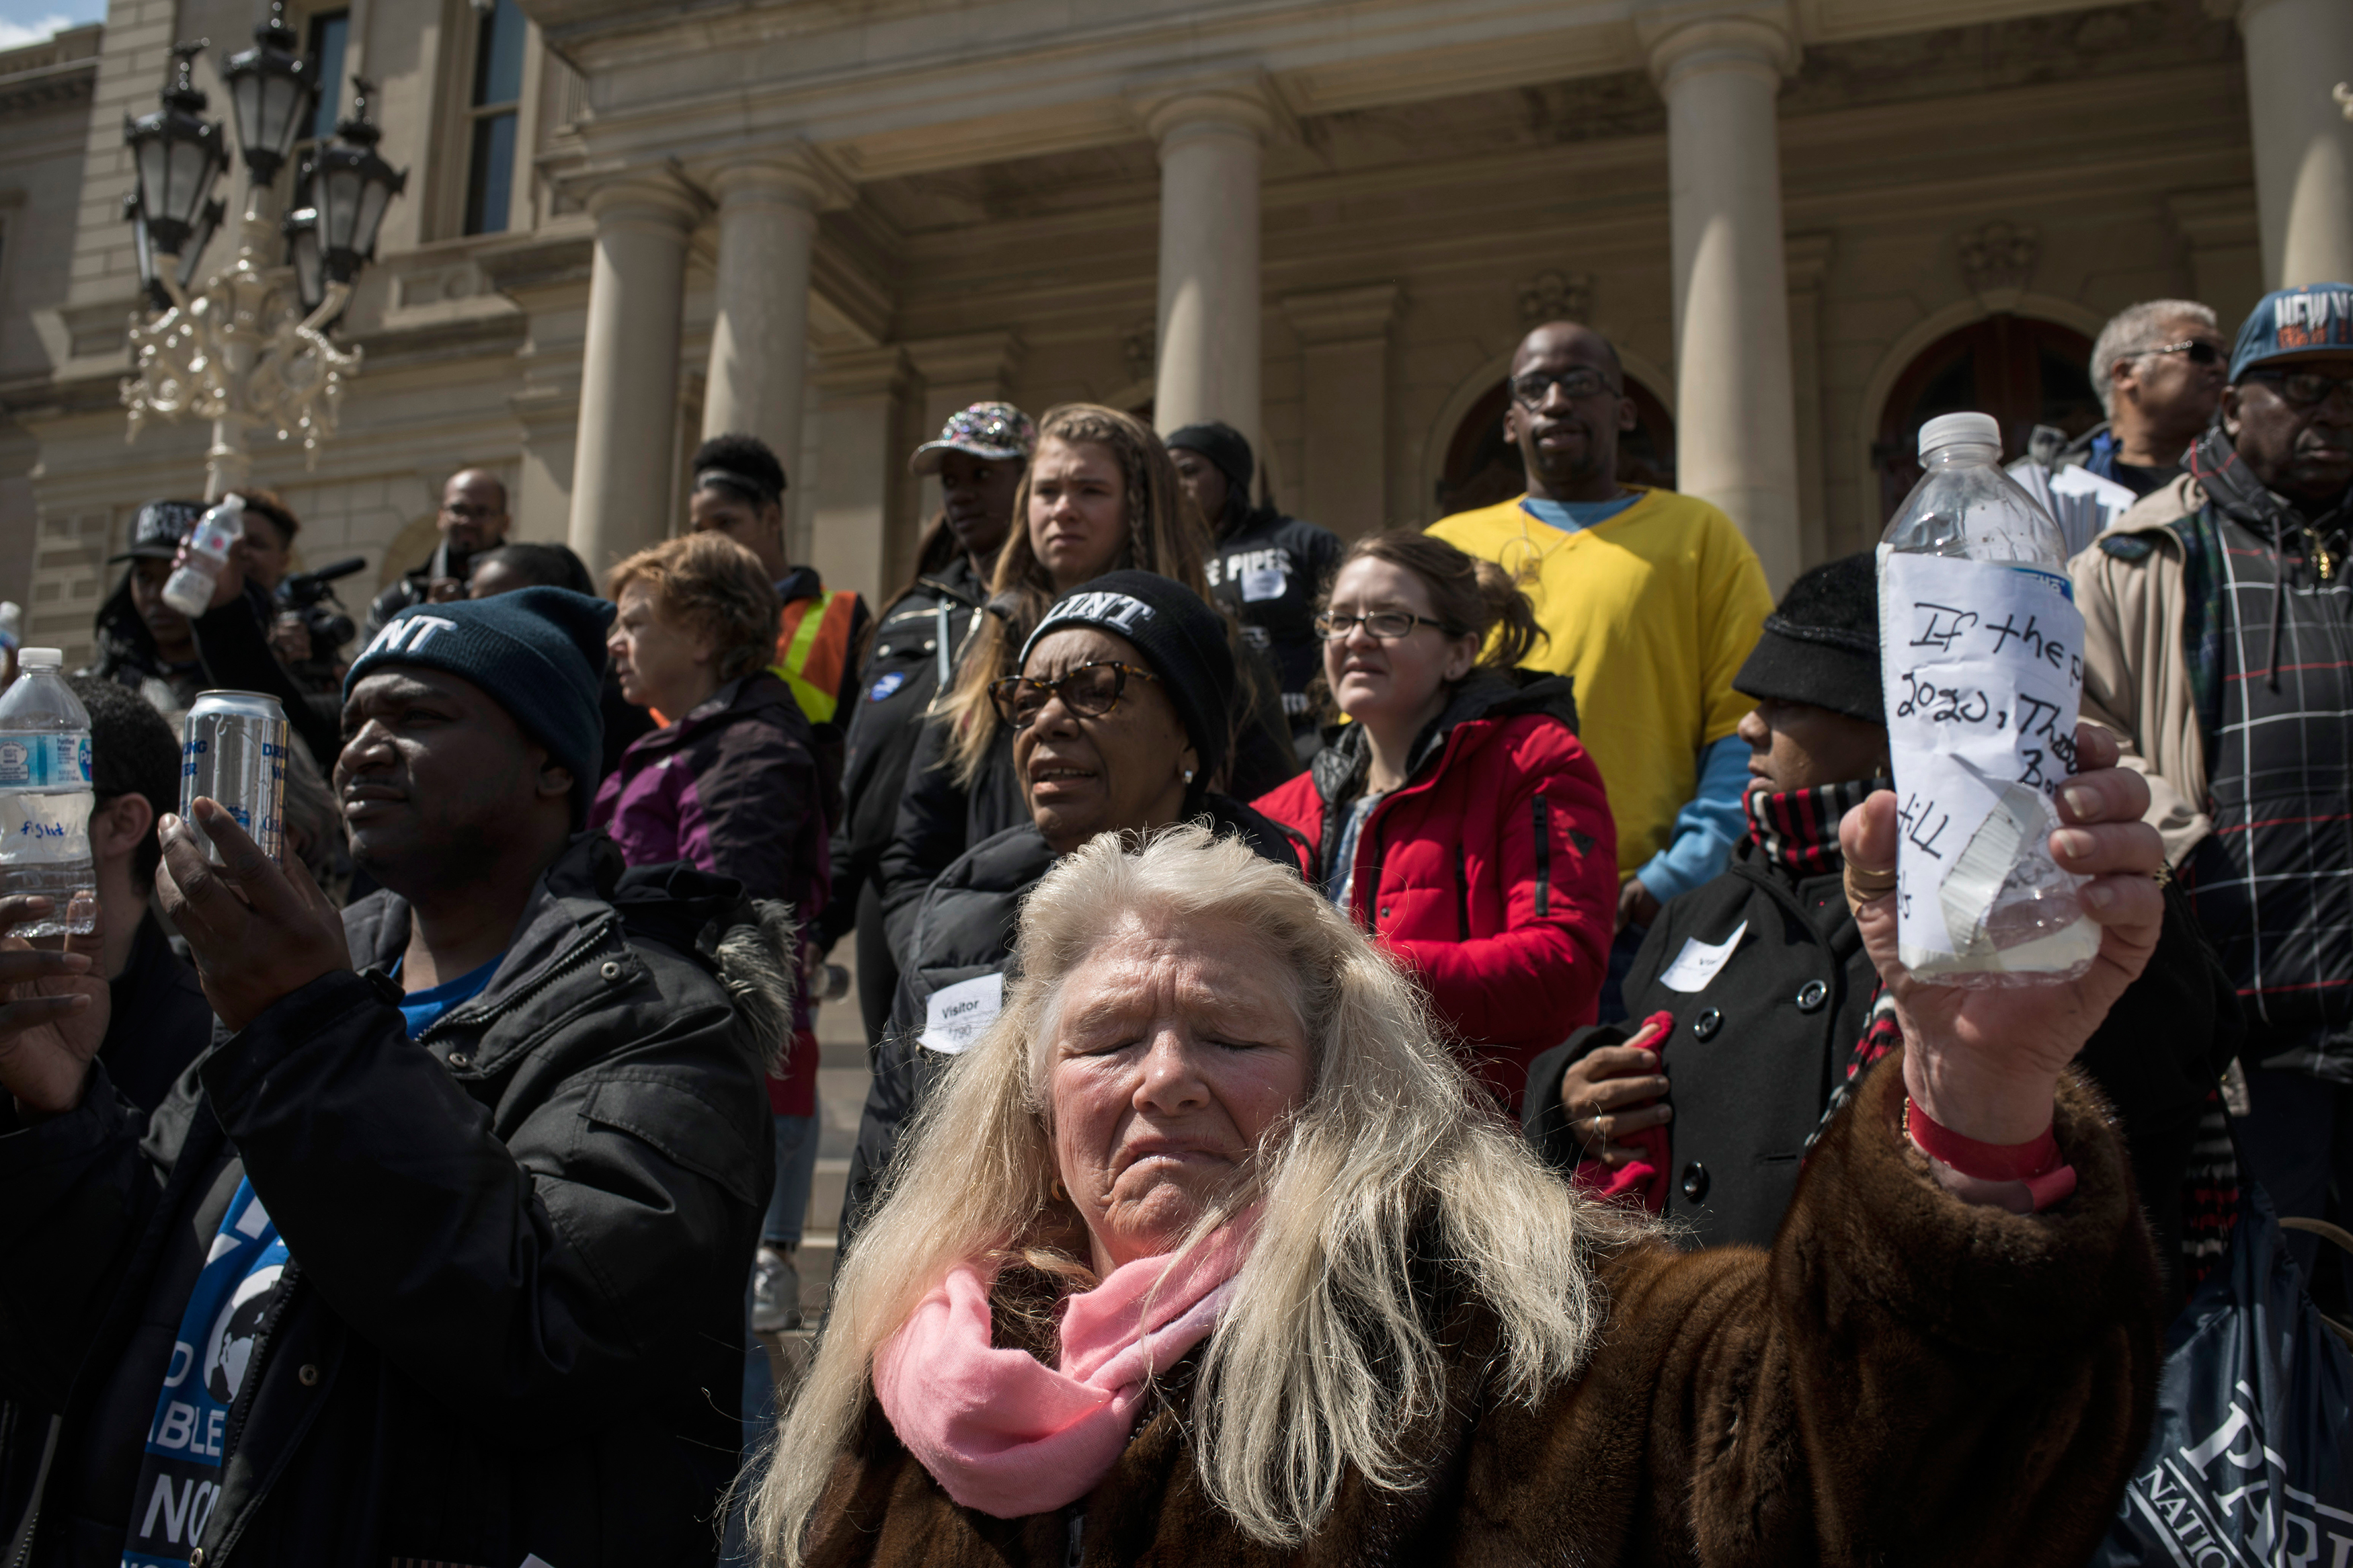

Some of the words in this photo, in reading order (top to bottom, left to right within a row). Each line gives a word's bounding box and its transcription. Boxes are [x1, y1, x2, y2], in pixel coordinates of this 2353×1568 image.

[348, 614, 458, 673] NT
[1019, 591, 1156, 664] INT
[1909, 602, 1978, 652] If
[1985, 614, 2065, 669] the
[182, 762, 198, 778] ER
[942, 1000, 980, 1020] Visitor
[147, 1400, 227, 1457] BLE
